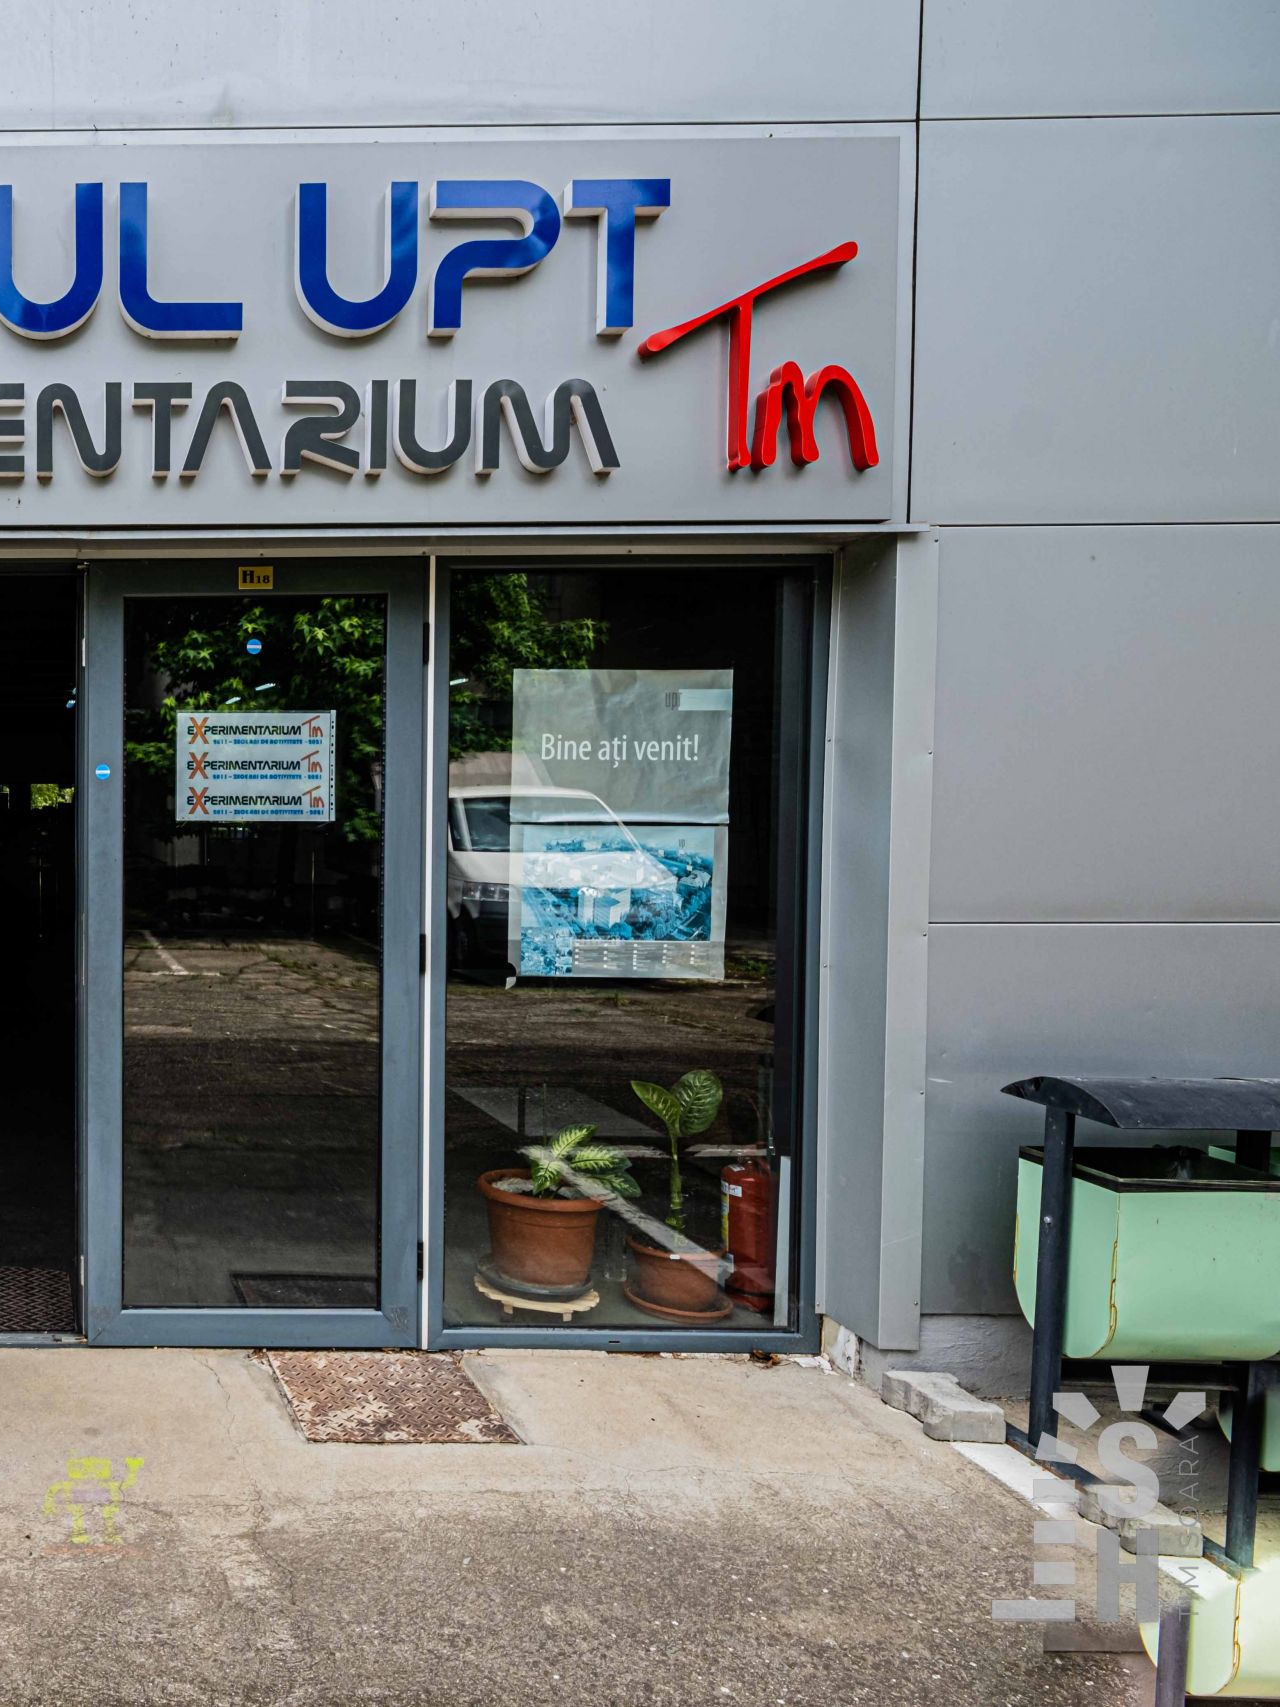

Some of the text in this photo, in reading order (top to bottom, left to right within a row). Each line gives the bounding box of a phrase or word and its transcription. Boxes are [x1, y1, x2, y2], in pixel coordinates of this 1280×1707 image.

[295, 179, 670, 338] UPT
[637, 240, 880, 473] Tm
[541, 733, 592, 760] Bine
[634, 734, 699, 761] venit!
